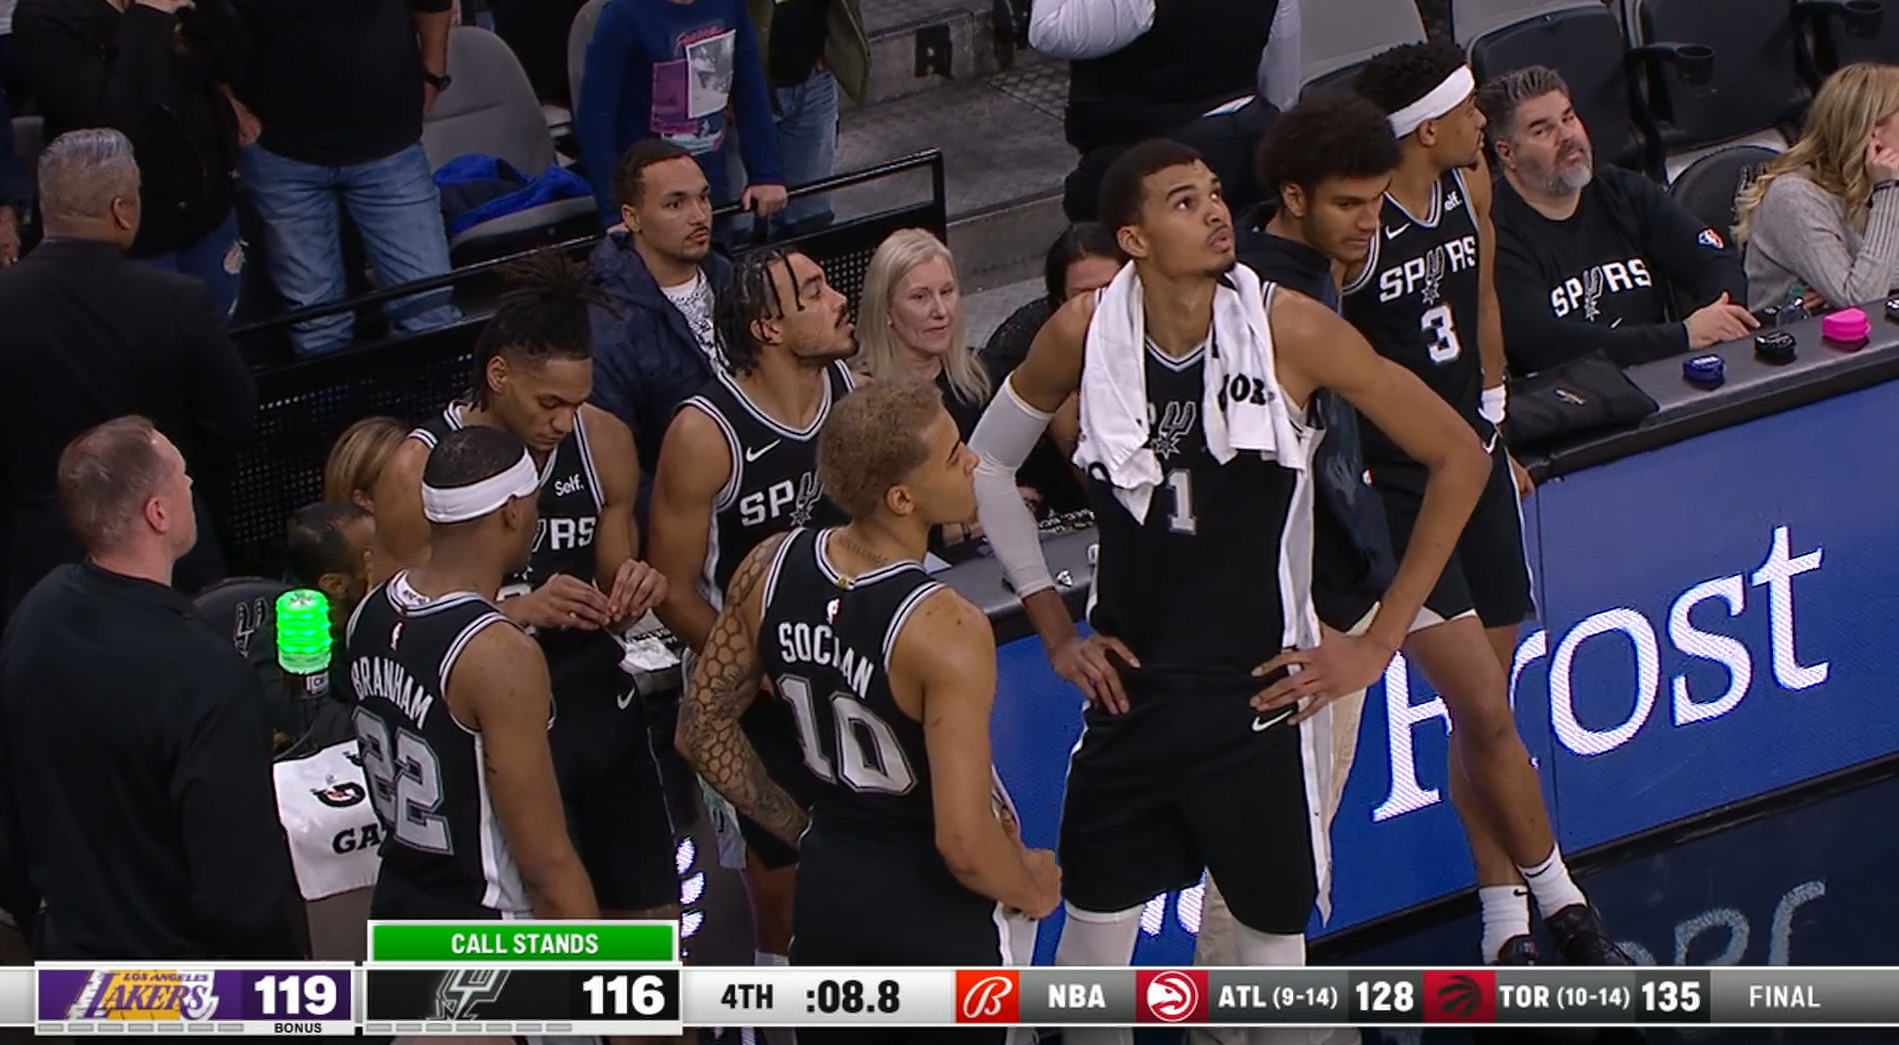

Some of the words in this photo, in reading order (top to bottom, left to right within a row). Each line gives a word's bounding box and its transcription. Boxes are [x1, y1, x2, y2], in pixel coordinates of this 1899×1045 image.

[1444, 190, 1463, 211] elf.
[1379, 235, 1478, 304] SPURS
[1550, 258, 1652, 322] SPURS
[1421, 305, 1461, 364] 3
[554, 473, 585, 497] Self.
[1167, 468, 1197, 535] 1
[351, 656, 434, 730] BRANHAM
[776, 673, 918, 796] 10
[351, 704, 453, 855] 22
